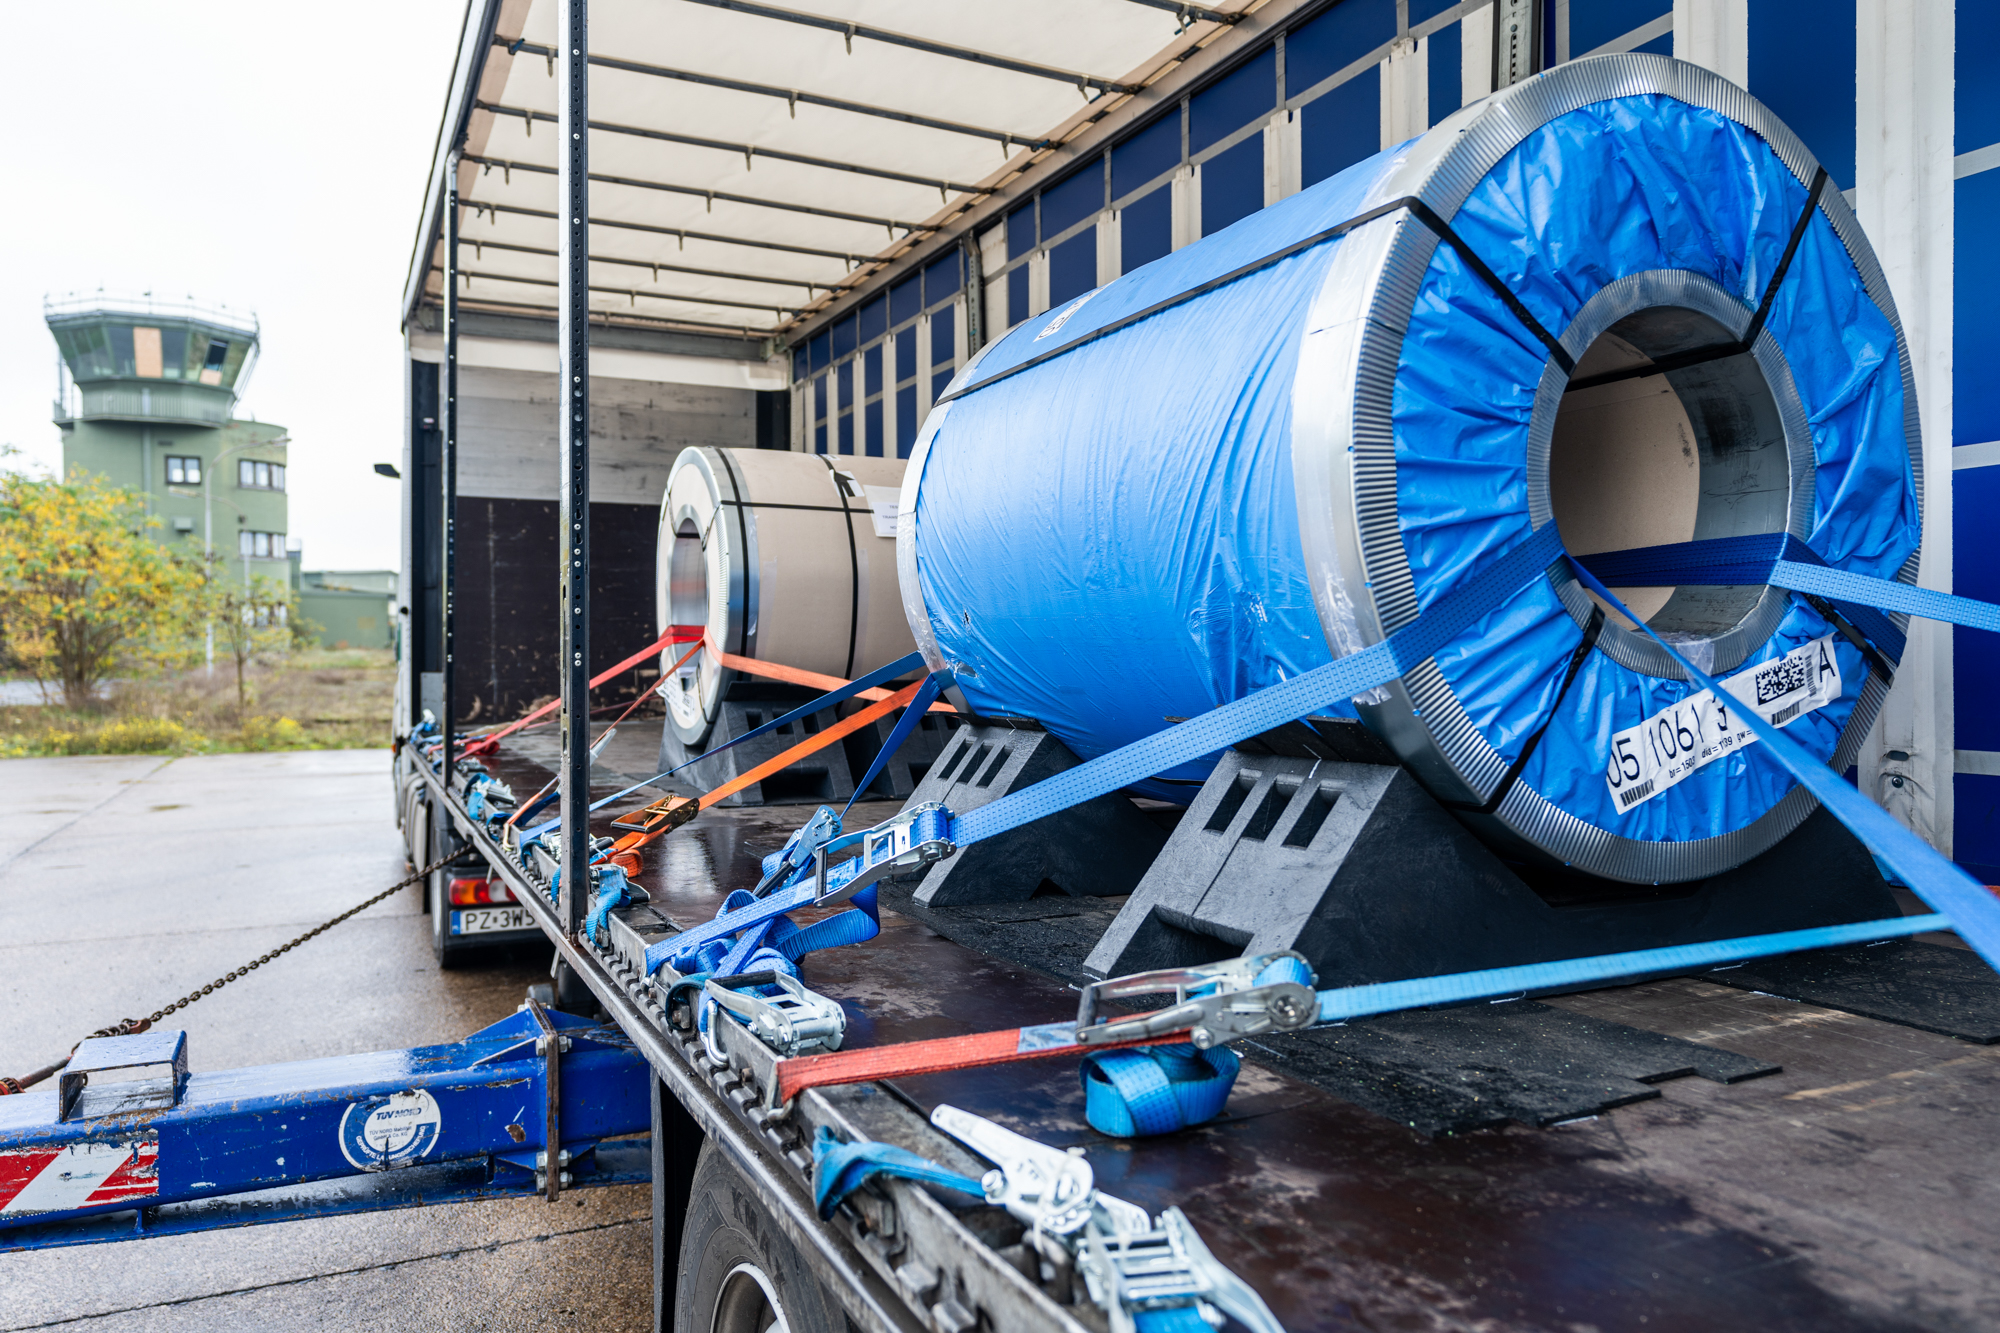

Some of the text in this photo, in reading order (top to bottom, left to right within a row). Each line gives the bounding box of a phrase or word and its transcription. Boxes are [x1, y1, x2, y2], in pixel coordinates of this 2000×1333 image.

[1817, 641, 1836, 683] A
[465, 911, 491, 931] PZ
[376, 1110, 395, 1120] TÜV
